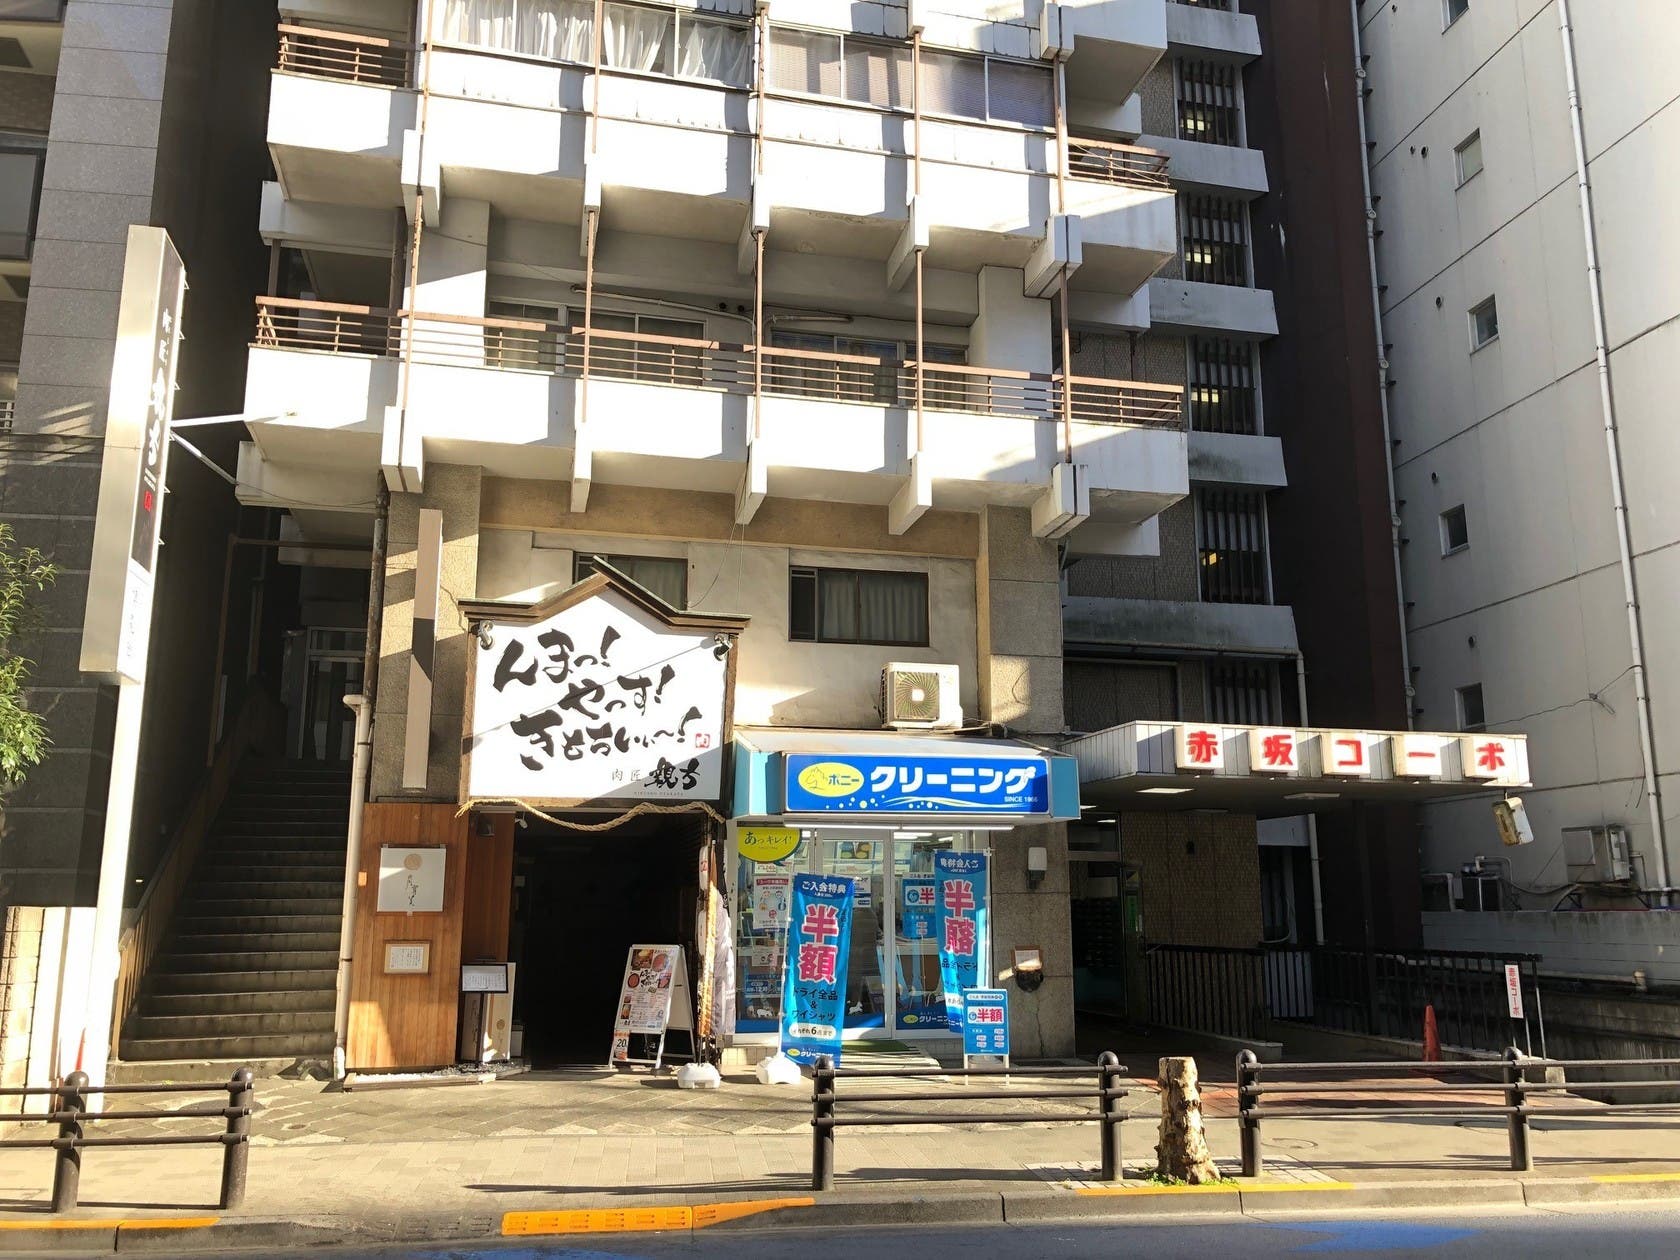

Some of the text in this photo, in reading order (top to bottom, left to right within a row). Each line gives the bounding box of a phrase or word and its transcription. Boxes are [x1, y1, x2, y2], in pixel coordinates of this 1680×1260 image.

[1186, 730, 1505, 772] 赤坂コーポ
[870, 765, 1036, 795] クリーニング
[801, 881, 846, 895] ご入会特典
[798, 903, 840, 985] 半額
[977, 1008, 1003, 1023] 半額
